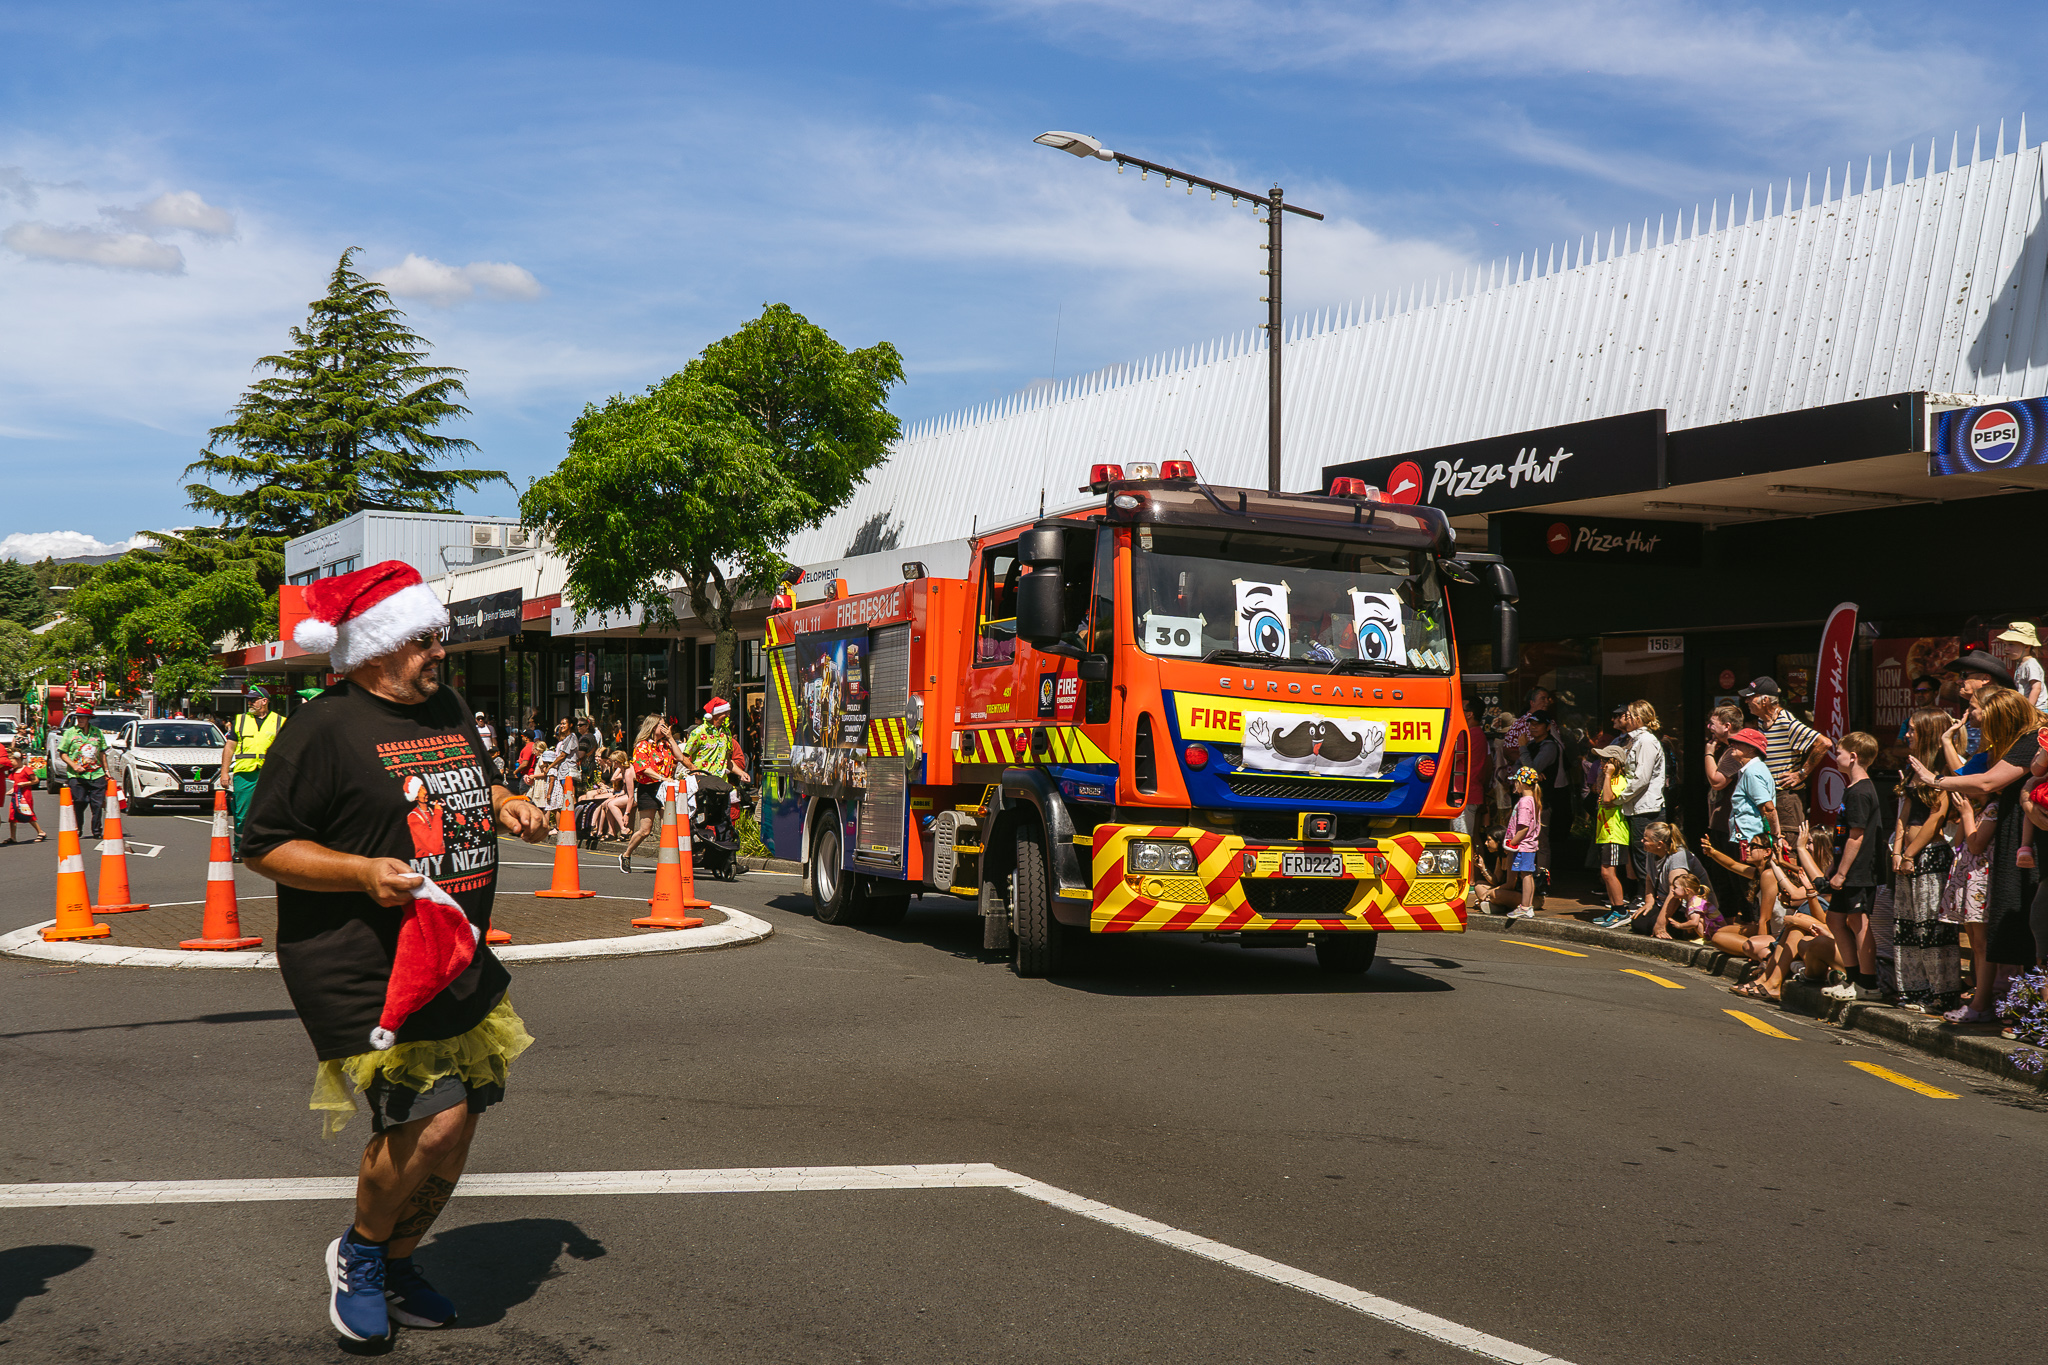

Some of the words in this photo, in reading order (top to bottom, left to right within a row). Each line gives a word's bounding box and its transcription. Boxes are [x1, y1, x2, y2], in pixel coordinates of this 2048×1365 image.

[1974, 427, 2016, 444] PEPSI
[1427, 458, 1506, 505] Pizza
[1507, 446, 1574, 489] Hut
[1574, 526, 1624, 552] Pizza
[1625, 530, 1662, 553] Hut
[800, 567, 839, 584] VELOPMENT
[837, 601, 858, 628] FIRE
[859, 591, 900, 623] RESCUE
[794, 618, 809, 635] CALL
[810, 615, 821, 631] 111
[1155, 626, 1191, 647] 30
[1650, 638, 1669, 650] 156
[1057, 678, 1078, 696] FIRE
[1876, 668, 1902, 688] NOW
[1219, 677, 1404, 700] EUROCARGO
[1876, 688, 1912, 706] UNDER
[986, 703, 1010, 714] TRENTHAM
[1191, 707, 1242, 732] FIRE
[422, 765, 486, 795] MERRY
[446, 787, 491, 812] CRIZZLE
[409, 854, 445, 877] MY
[1285, 856, 1341, 873] FRD223
